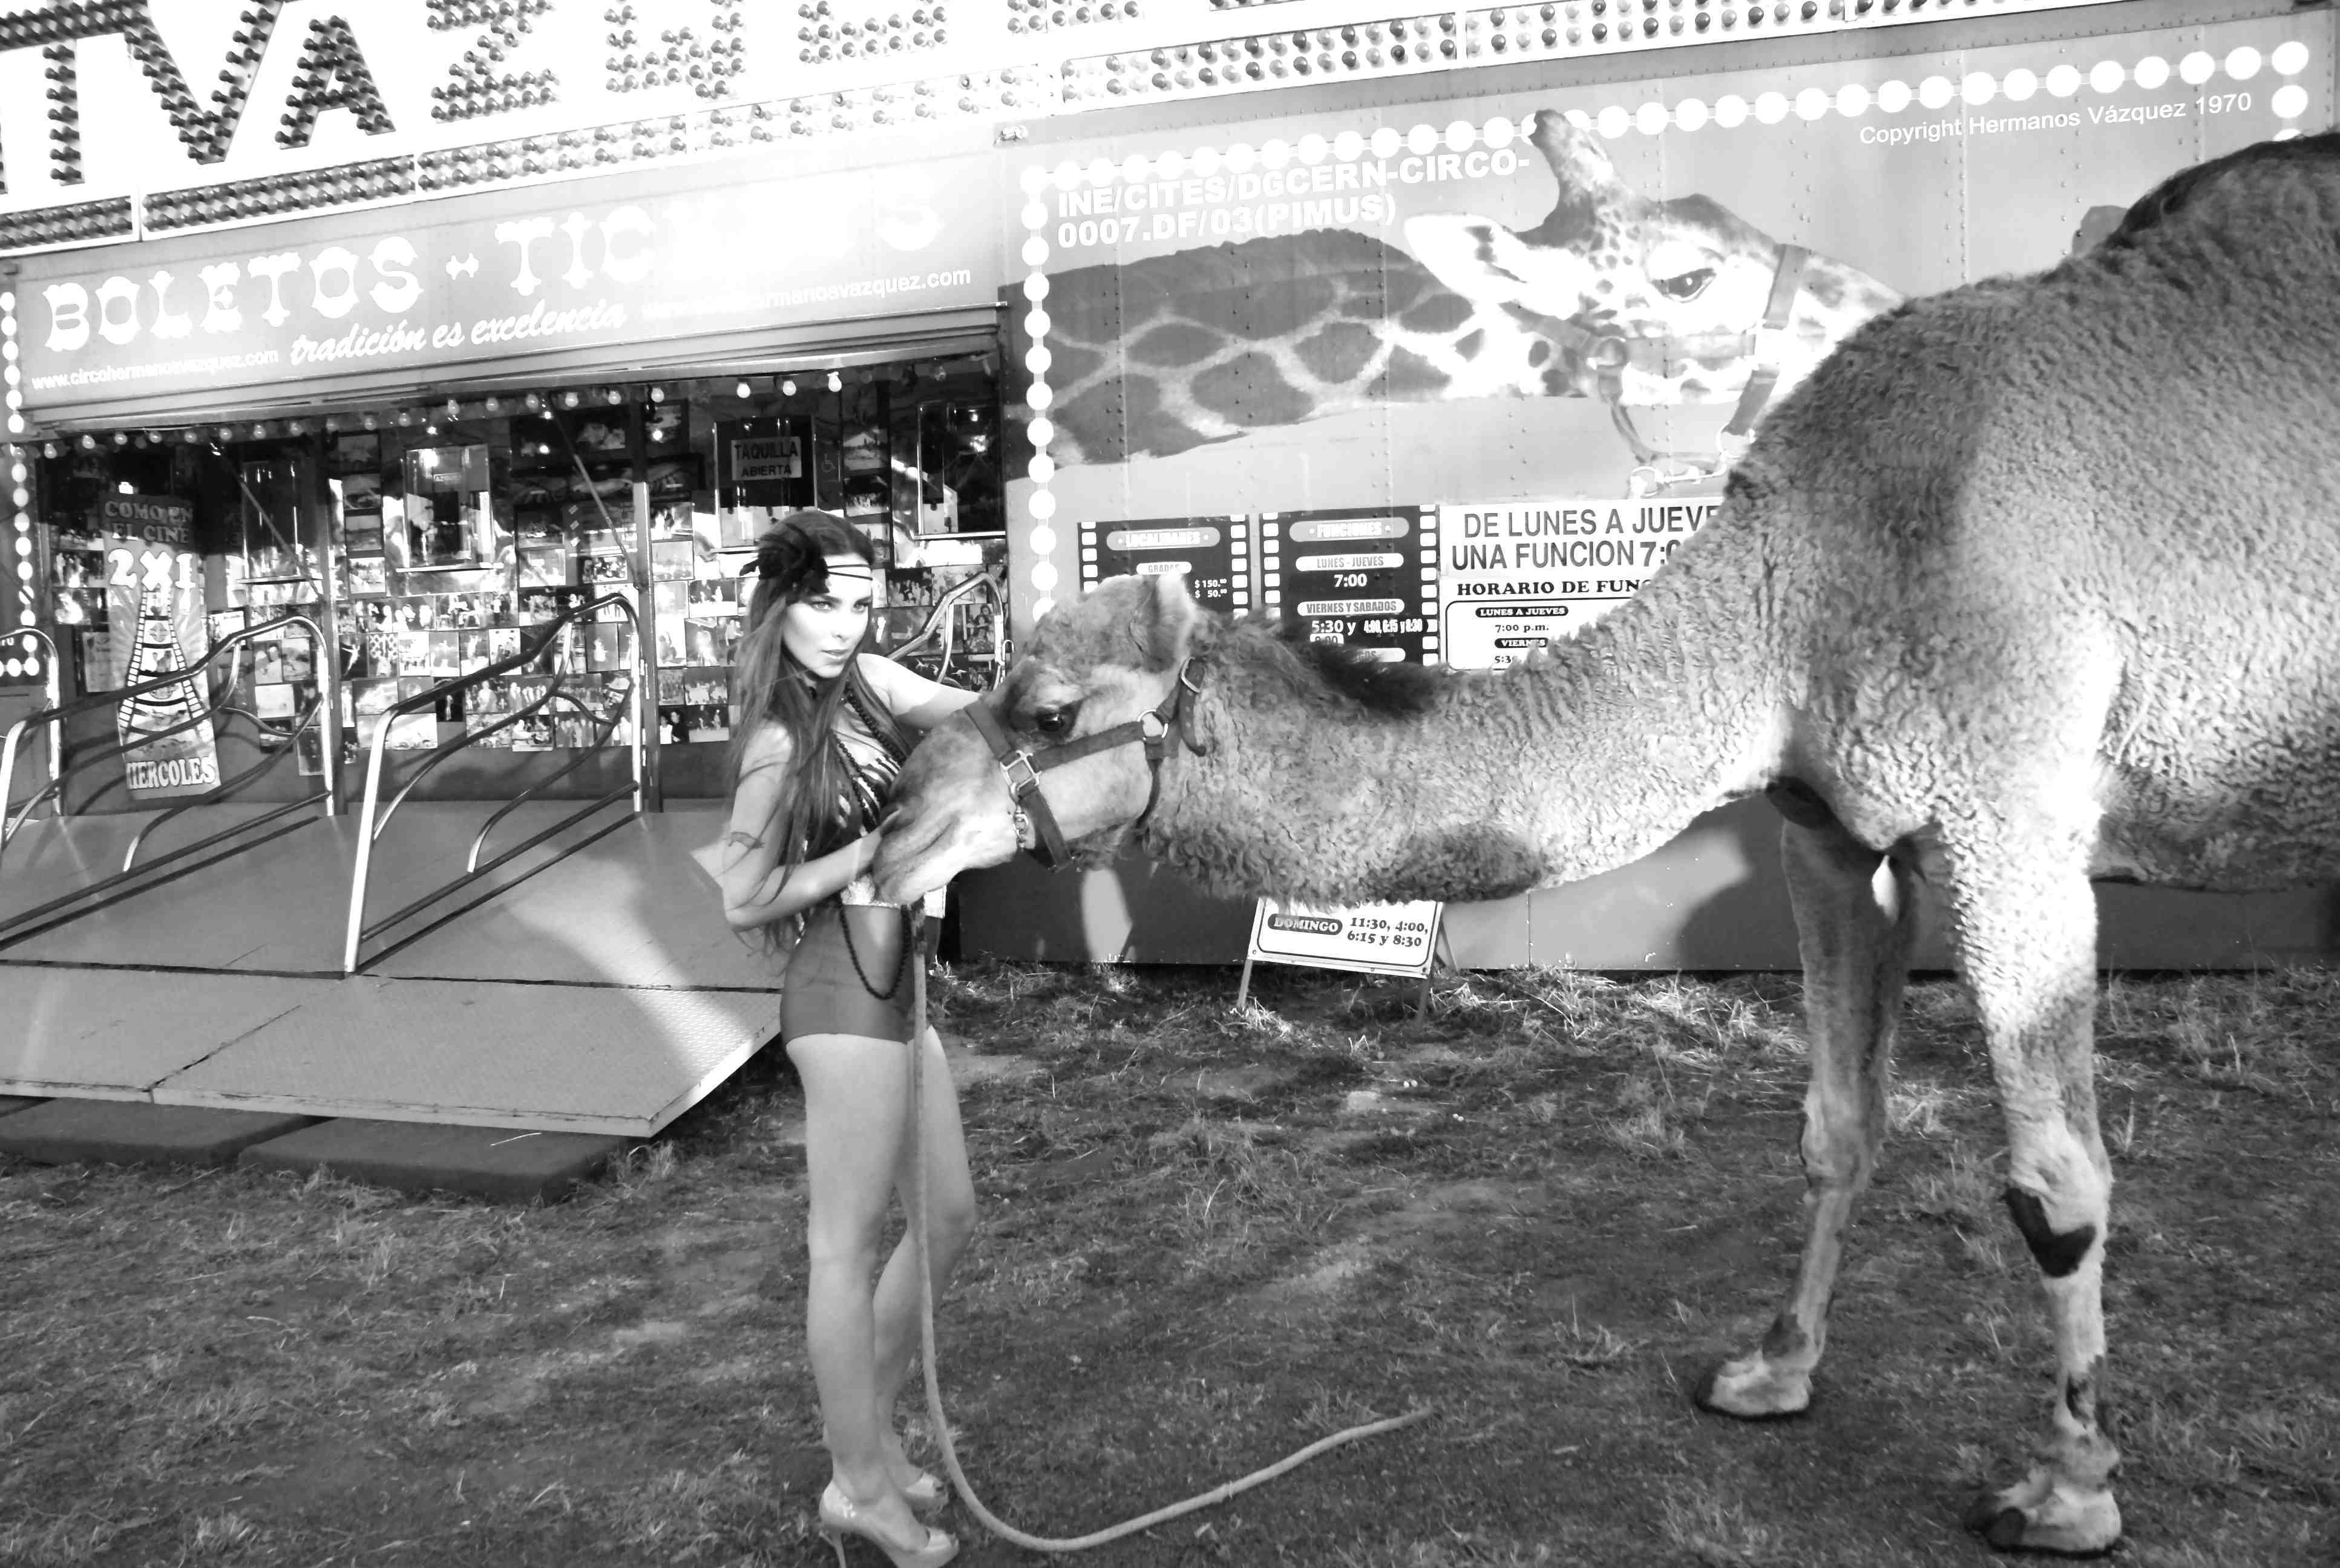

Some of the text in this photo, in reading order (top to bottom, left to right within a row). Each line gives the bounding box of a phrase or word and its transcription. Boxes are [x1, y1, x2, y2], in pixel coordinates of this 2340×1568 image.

[1859, 92, 2252, 145] Copyright Hermanos Vázquez 1970
[42, 236, 424, 352] BOLETOS
[290, 299, 628, 365] tradición es excelencia
[734, 440, 798, 460] TAQUILLA
[741, 464, 792, 477] ABIERTA
[105, 500, 193, 523] COMO EN
[1464, 512, 1499, 538] DE
[1508, 509, 1597, 537] LUNES
[1605, 508, 1624, 534] A
[111, 523, 189, 543] EL CINE
[1317, 557, 1345, 569] LUNES
[1351, 555, 1385, 567] JUEVES
[1452, 544, 1507, 570] UNA
[1515, 540, 1634, 569] FUNCION
[1333, 573, 1368, 588] 7:00
[1457, 581, 1555, 596] HORARIO
[1561, 580, 1590, 593] DE
[1306, 601, 1397, 614] VIERNES Y SABADOS
[1311, 619, 1357, 636] 5:30 y
[1495, 624, 1549, 633] 7:00 p.m.
[1273, 916, 1429, 935] DOMINGO 11:30, 4:00,
[1347, 930, 1423, 947] 6:15 y 8:30
